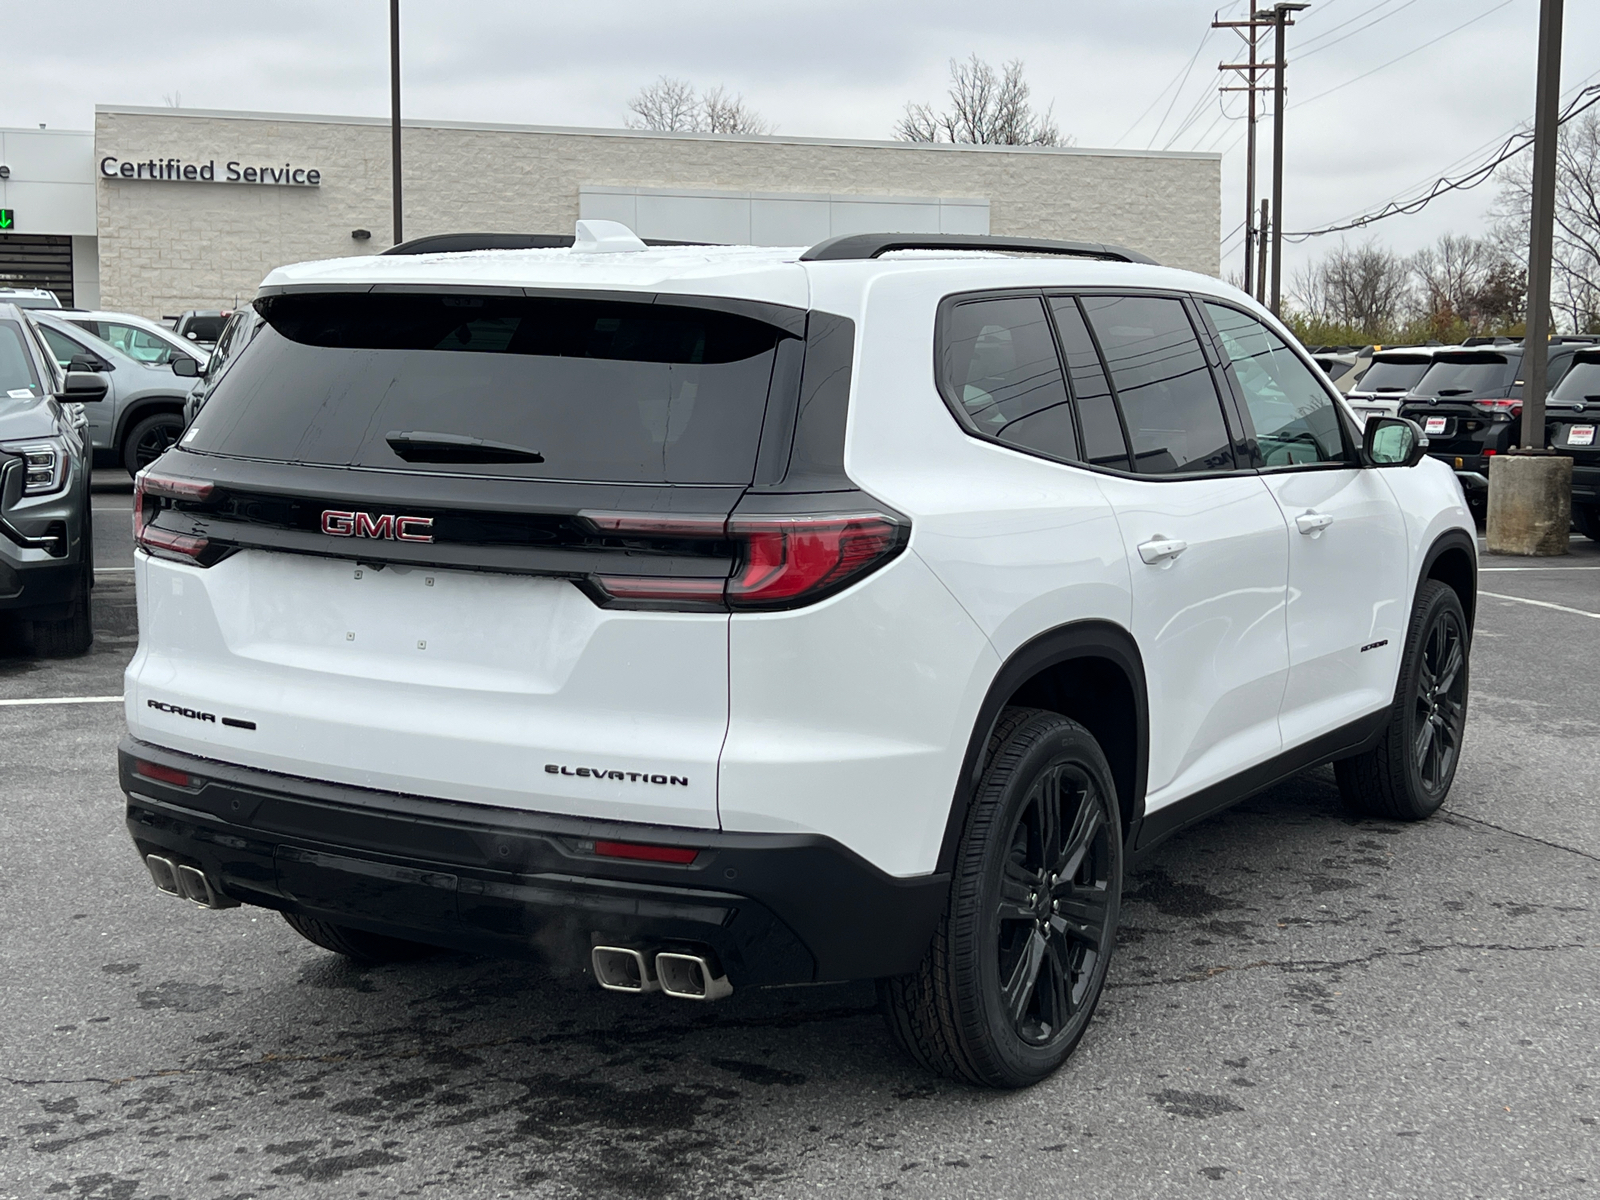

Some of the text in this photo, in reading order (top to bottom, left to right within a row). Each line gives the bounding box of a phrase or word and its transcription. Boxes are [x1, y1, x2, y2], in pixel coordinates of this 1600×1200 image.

[101, 157, 321, 185] Certified Service
[321, 509, 434, 544] GMC
[147, 699, 216, 723] ACADIA
[544, 764, 689, 786] ELEVATION
